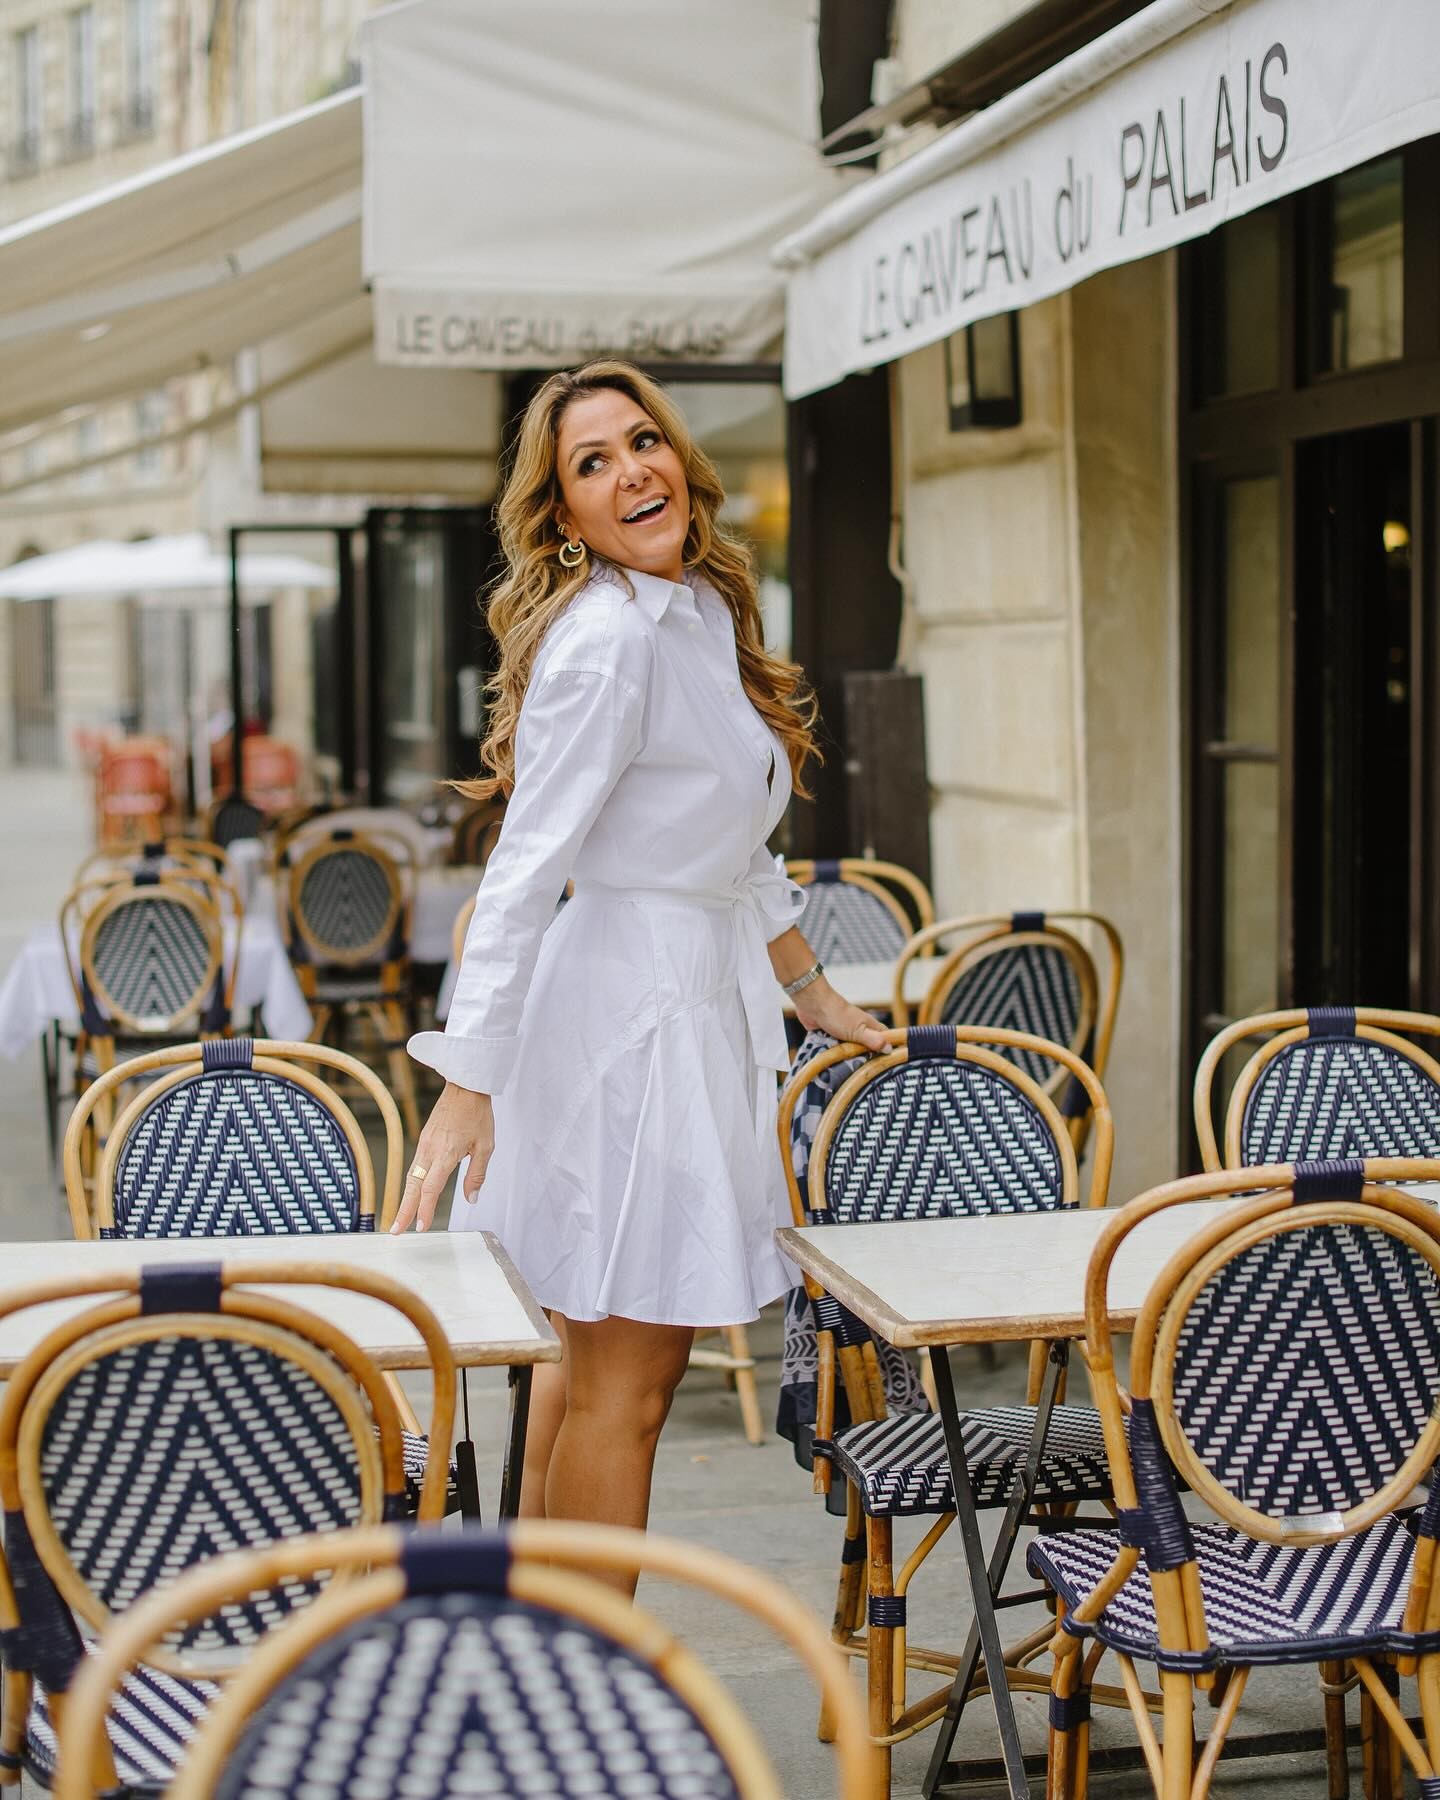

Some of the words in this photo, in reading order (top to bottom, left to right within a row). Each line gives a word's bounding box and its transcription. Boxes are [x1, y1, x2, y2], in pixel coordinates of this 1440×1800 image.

[861, 257, 891, 345] LE
[899, 179, 1035, 328] CAVEAU
[1055, 157, 1093, 263] du
[1119, 42, 1289, 236] PALAIS
[397, 314, 435, 355] LE
[442, 314, 566, 356] CAVEAU
